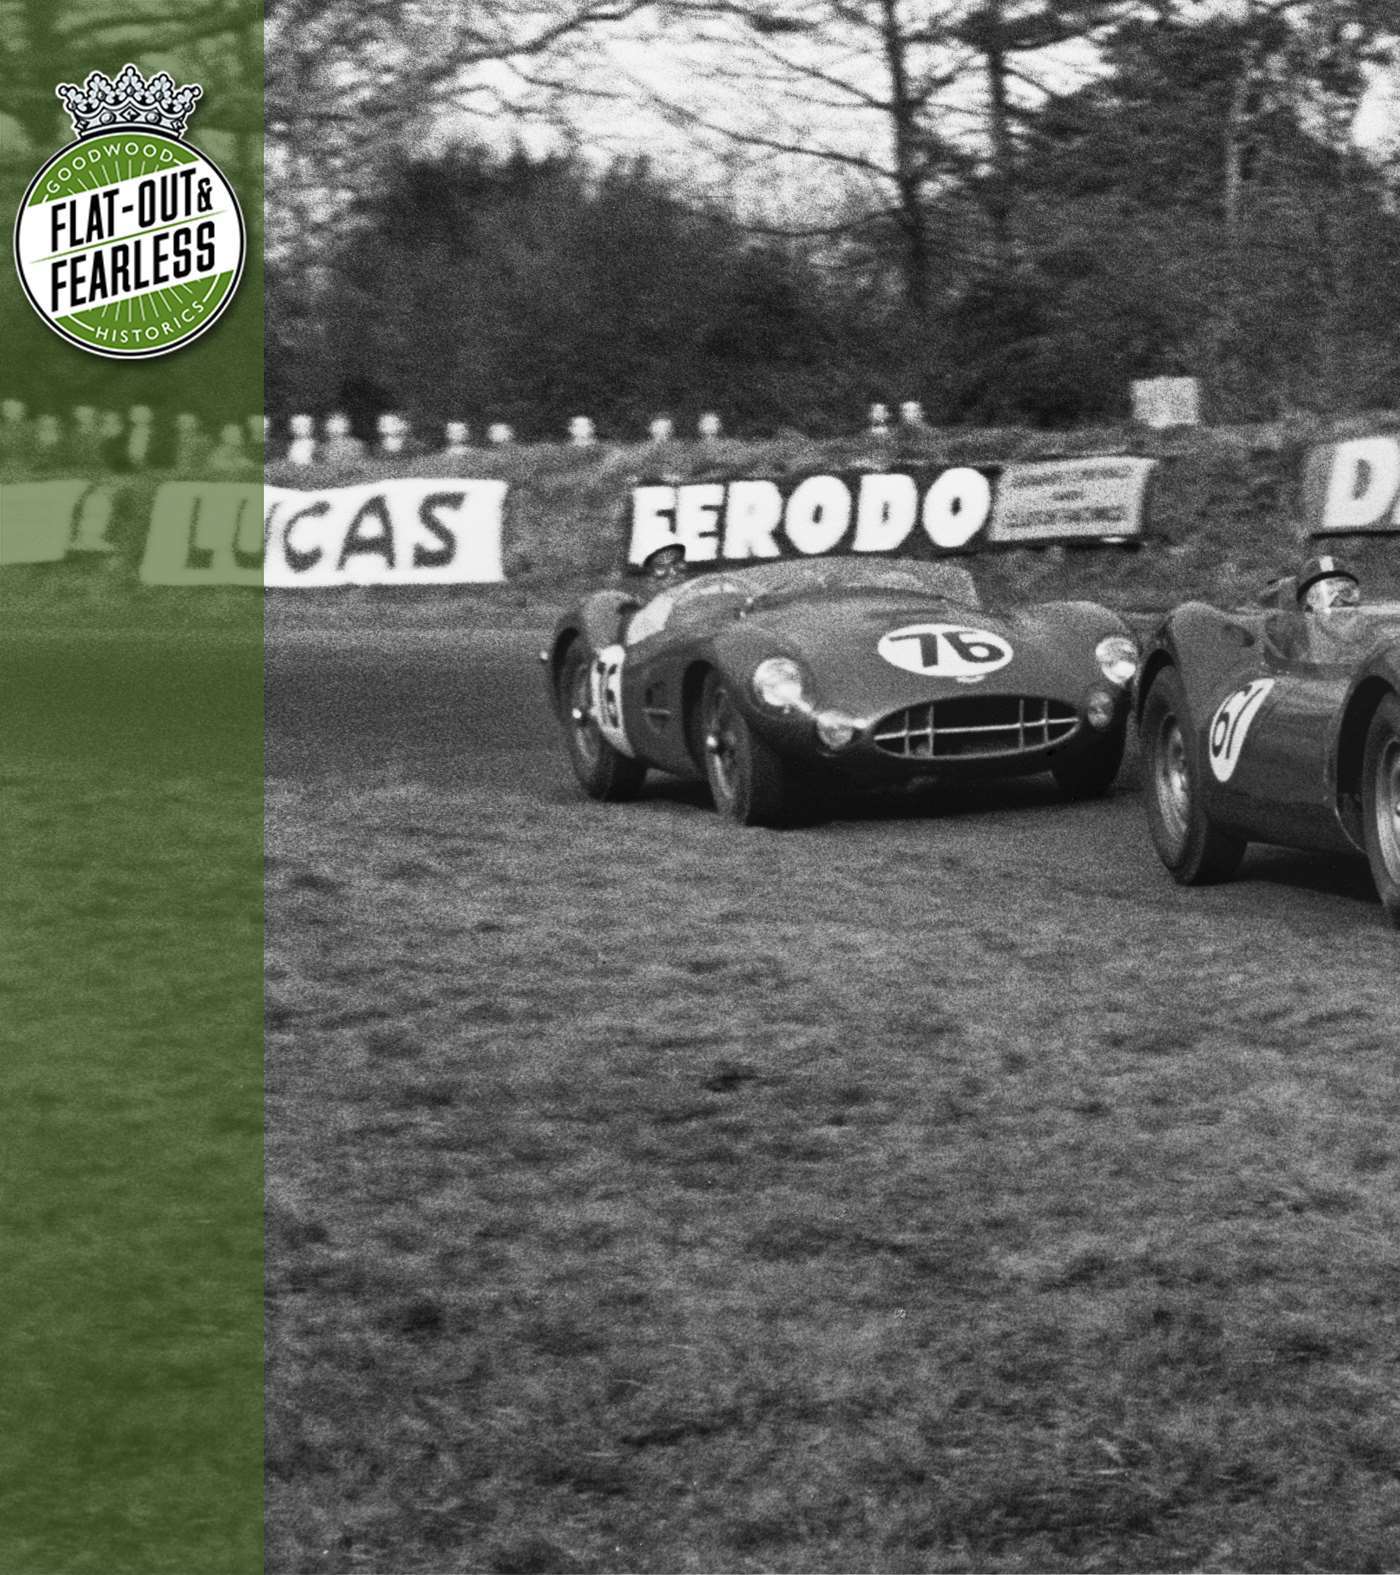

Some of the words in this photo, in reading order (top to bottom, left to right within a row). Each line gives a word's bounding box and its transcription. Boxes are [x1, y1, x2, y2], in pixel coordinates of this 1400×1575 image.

[184, 492, 468, 573] LUCAS
[628, 466, 991, 566] FERODO
[889, 630, 1006, 668] 76
[1212, 684, 1264, 760] 61
